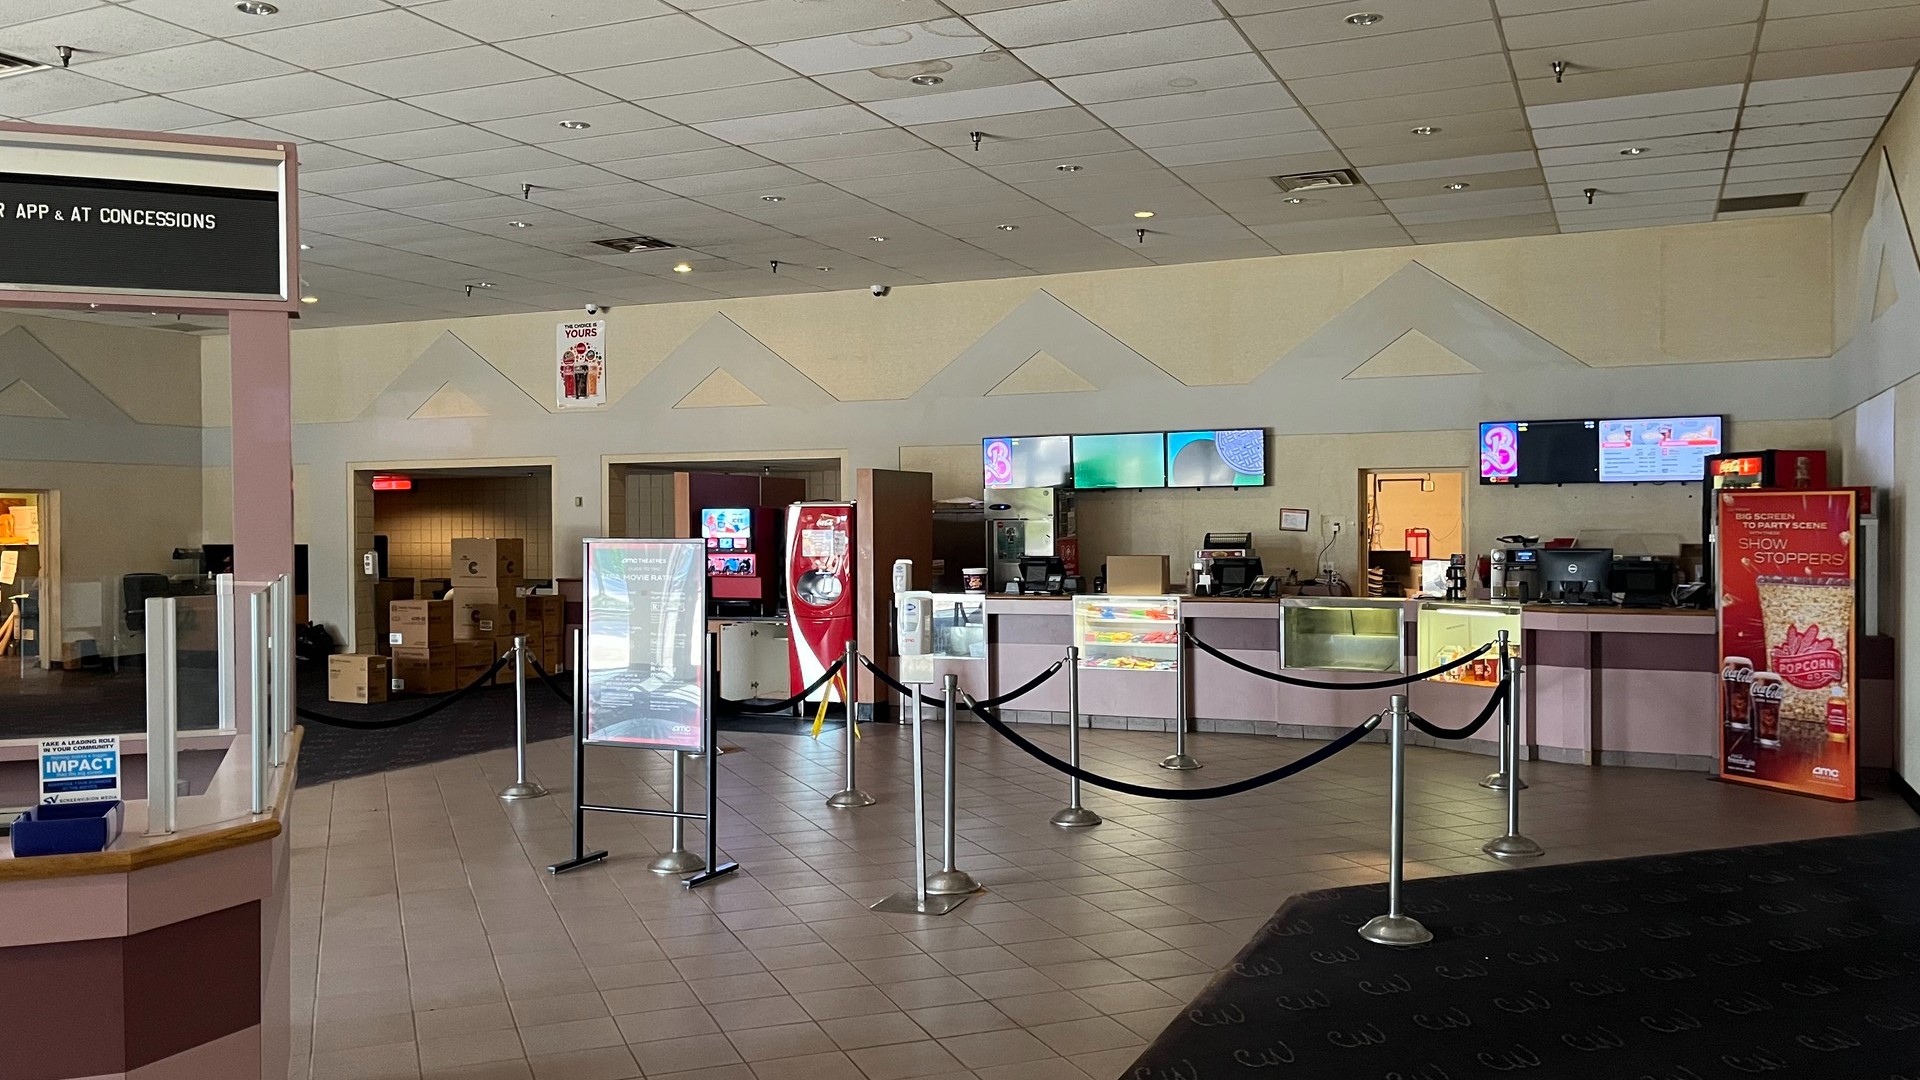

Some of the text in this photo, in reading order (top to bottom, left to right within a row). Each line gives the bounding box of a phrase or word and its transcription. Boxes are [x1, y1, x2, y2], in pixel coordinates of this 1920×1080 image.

[16, 203, 49, 219] APP
[54, 210, 64, 221] &
[71, 207, 91, 222] AT
[100, 208, 216, 229] CONCESSIONS
[565, 328, 597, 338] YOURS
[1738, 538, 1788, 549] SHOW
[1754, 551, 1844, 566] STOPPERS
[1779, 659, 1835, 674] POPCORN
[46, 758, 113, 773] IMPACT
[1812, 766, 1839, 777] amc
